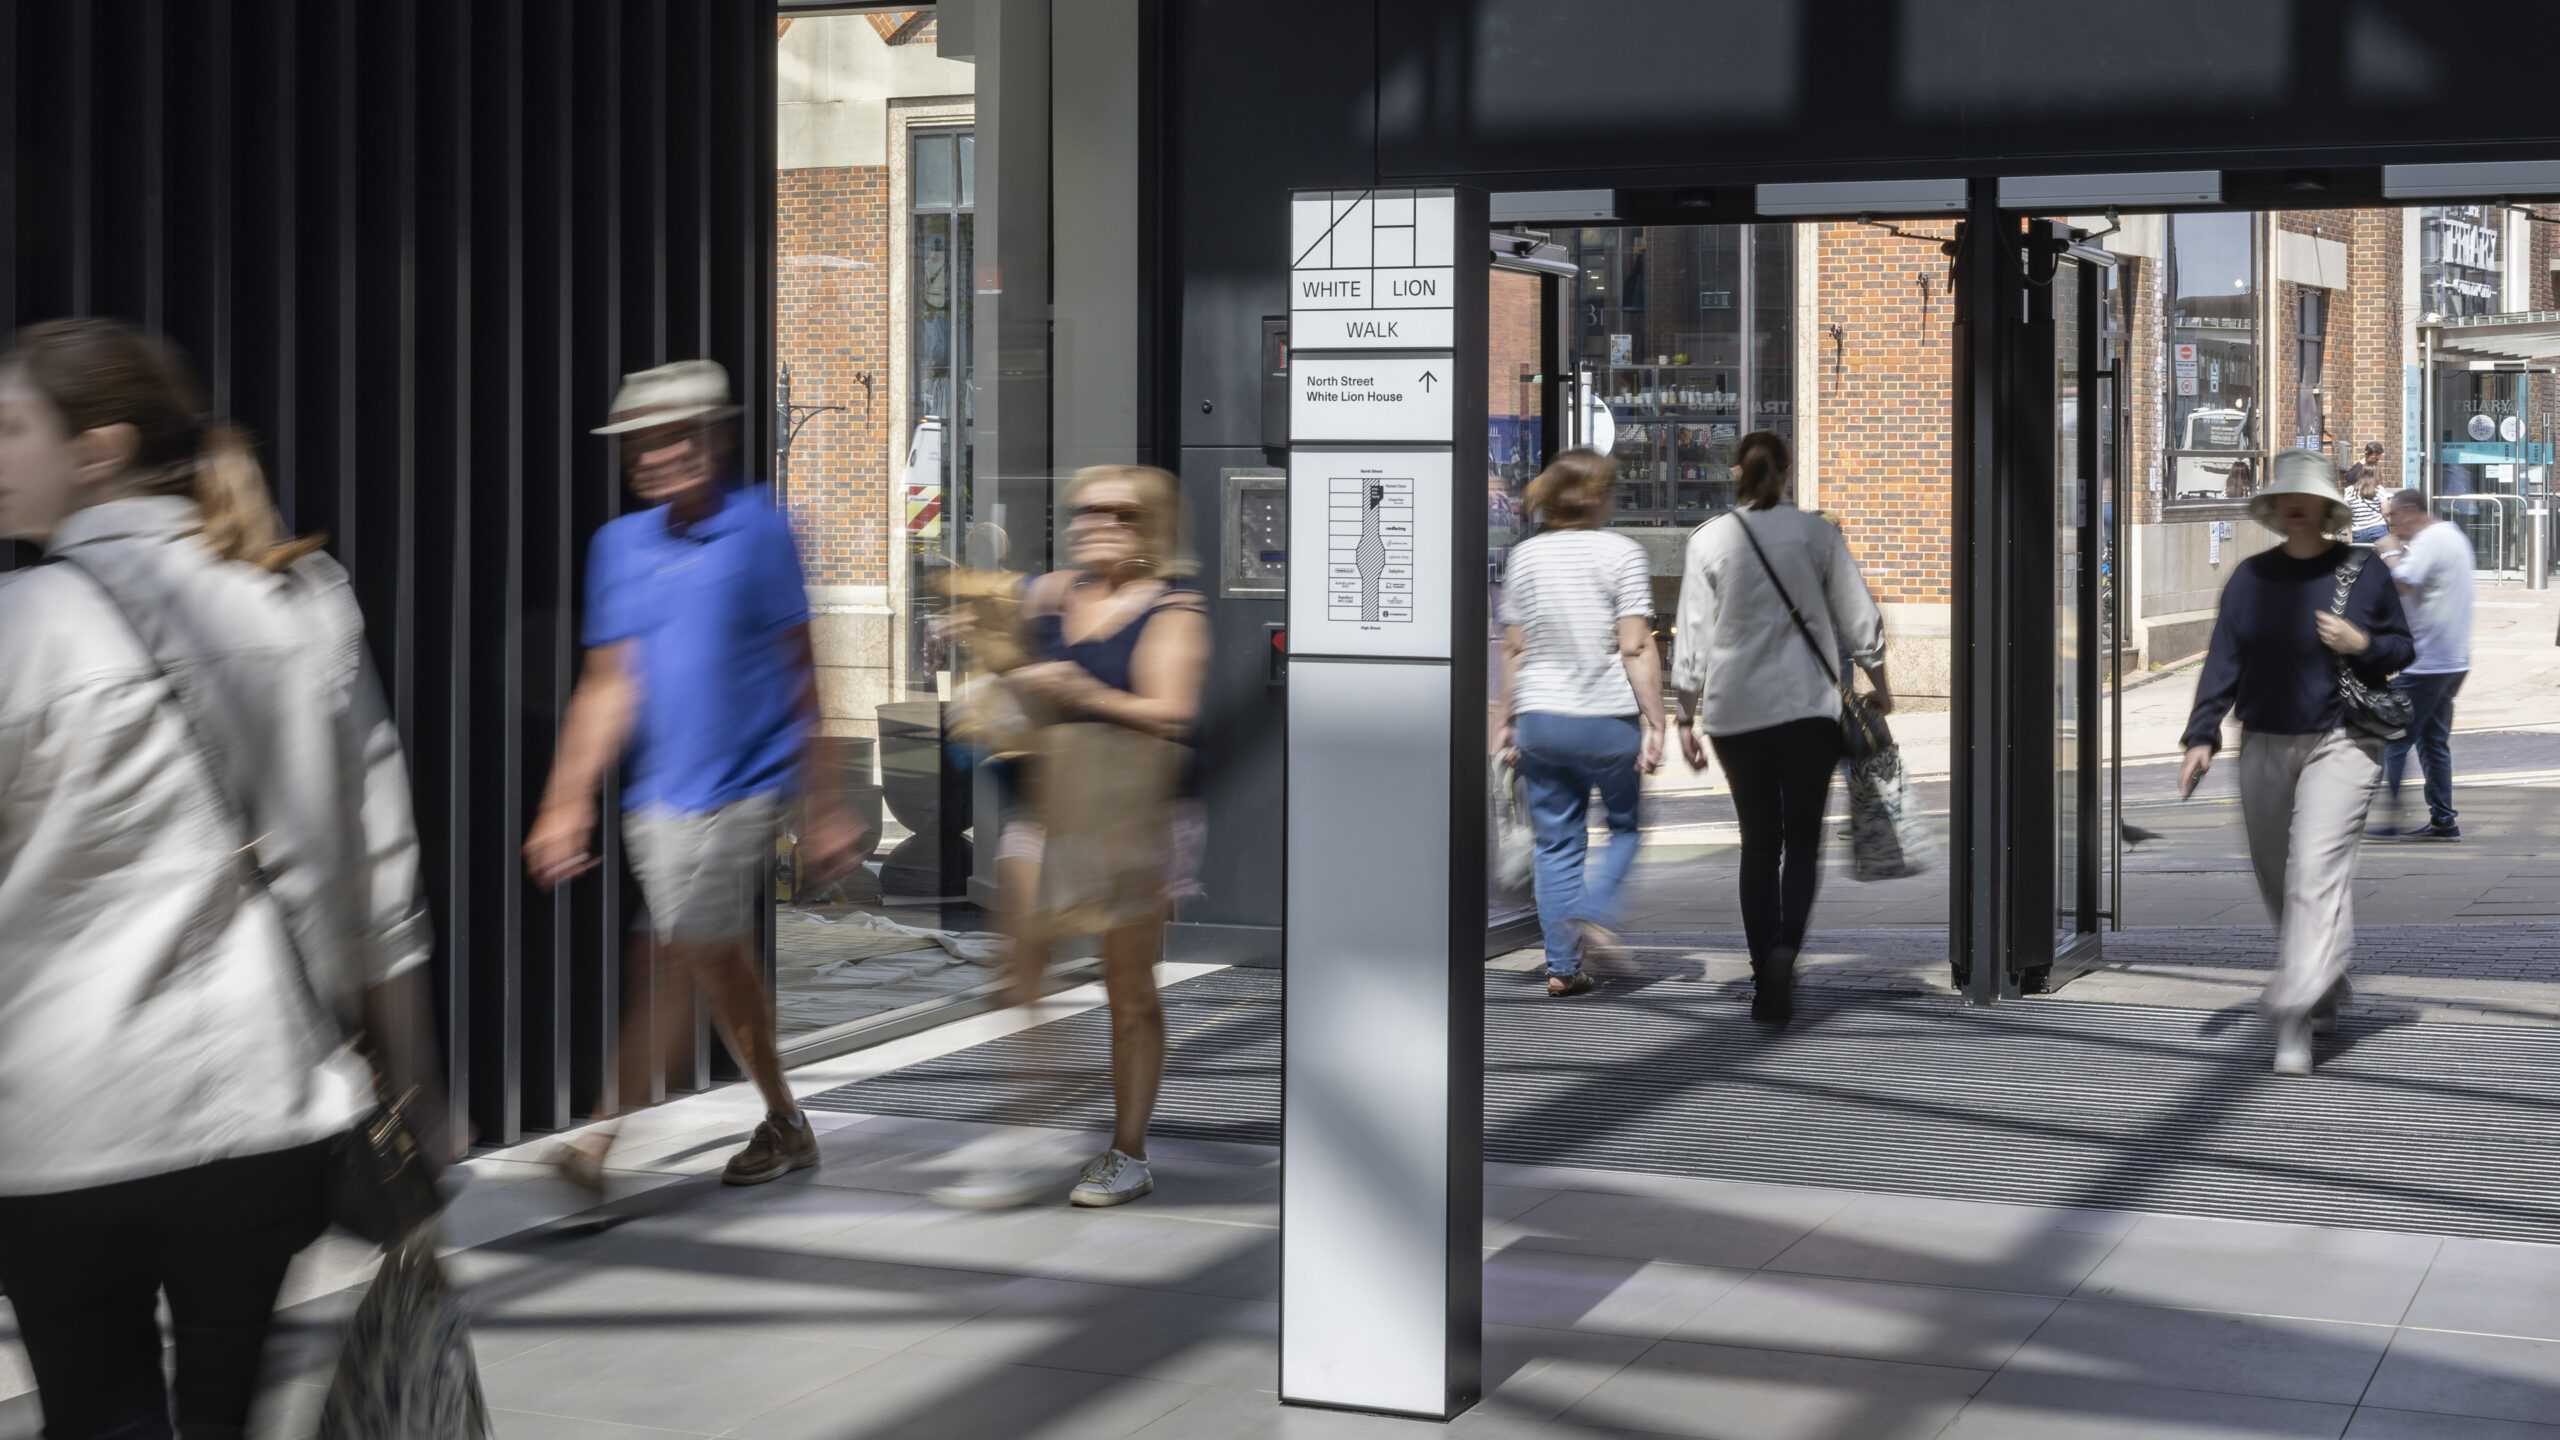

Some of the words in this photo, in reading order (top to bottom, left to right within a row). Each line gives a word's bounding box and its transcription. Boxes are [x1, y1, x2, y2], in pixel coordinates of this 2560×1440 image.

[1303, 281, 1361, 297] WHITE
[1393, 280, 1436, 296] LION
[1346, 321, 1399, 338] WALK
[1307, 376, 1338, 386] North
[1340, 376, 1374, 386] Street
[1306, 391, 1338, 402] White
[1341, 391, 1364, 402] Lion
[1367, 391, 1403, 402] House
